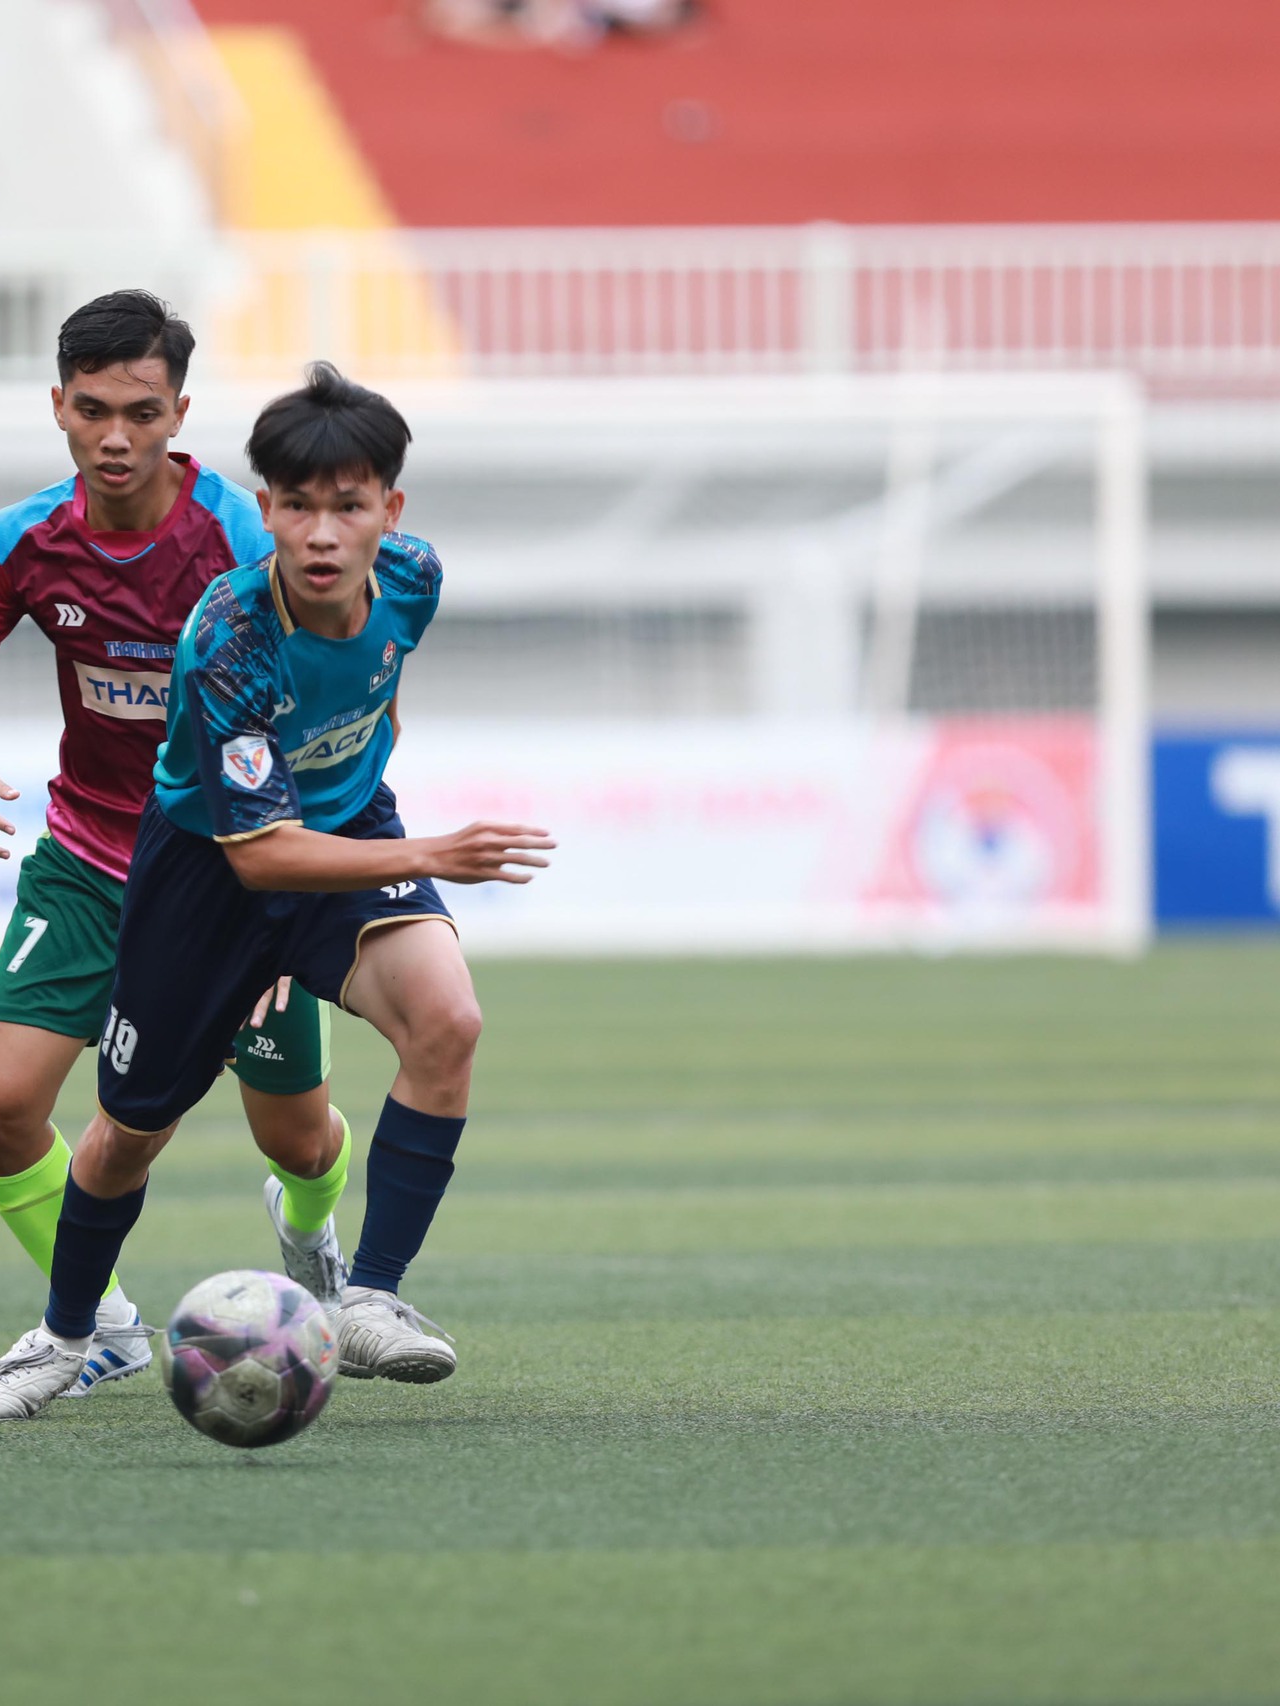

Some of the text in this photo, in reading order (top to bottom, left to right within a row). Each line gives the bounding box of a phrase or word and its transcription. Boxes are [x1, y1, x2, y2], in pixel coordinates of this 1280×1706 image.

[6, 916, 49, 973] 7
[101, 1004, 138, 1075] 19
[247, 1045, 285, 1061] BULBAL
